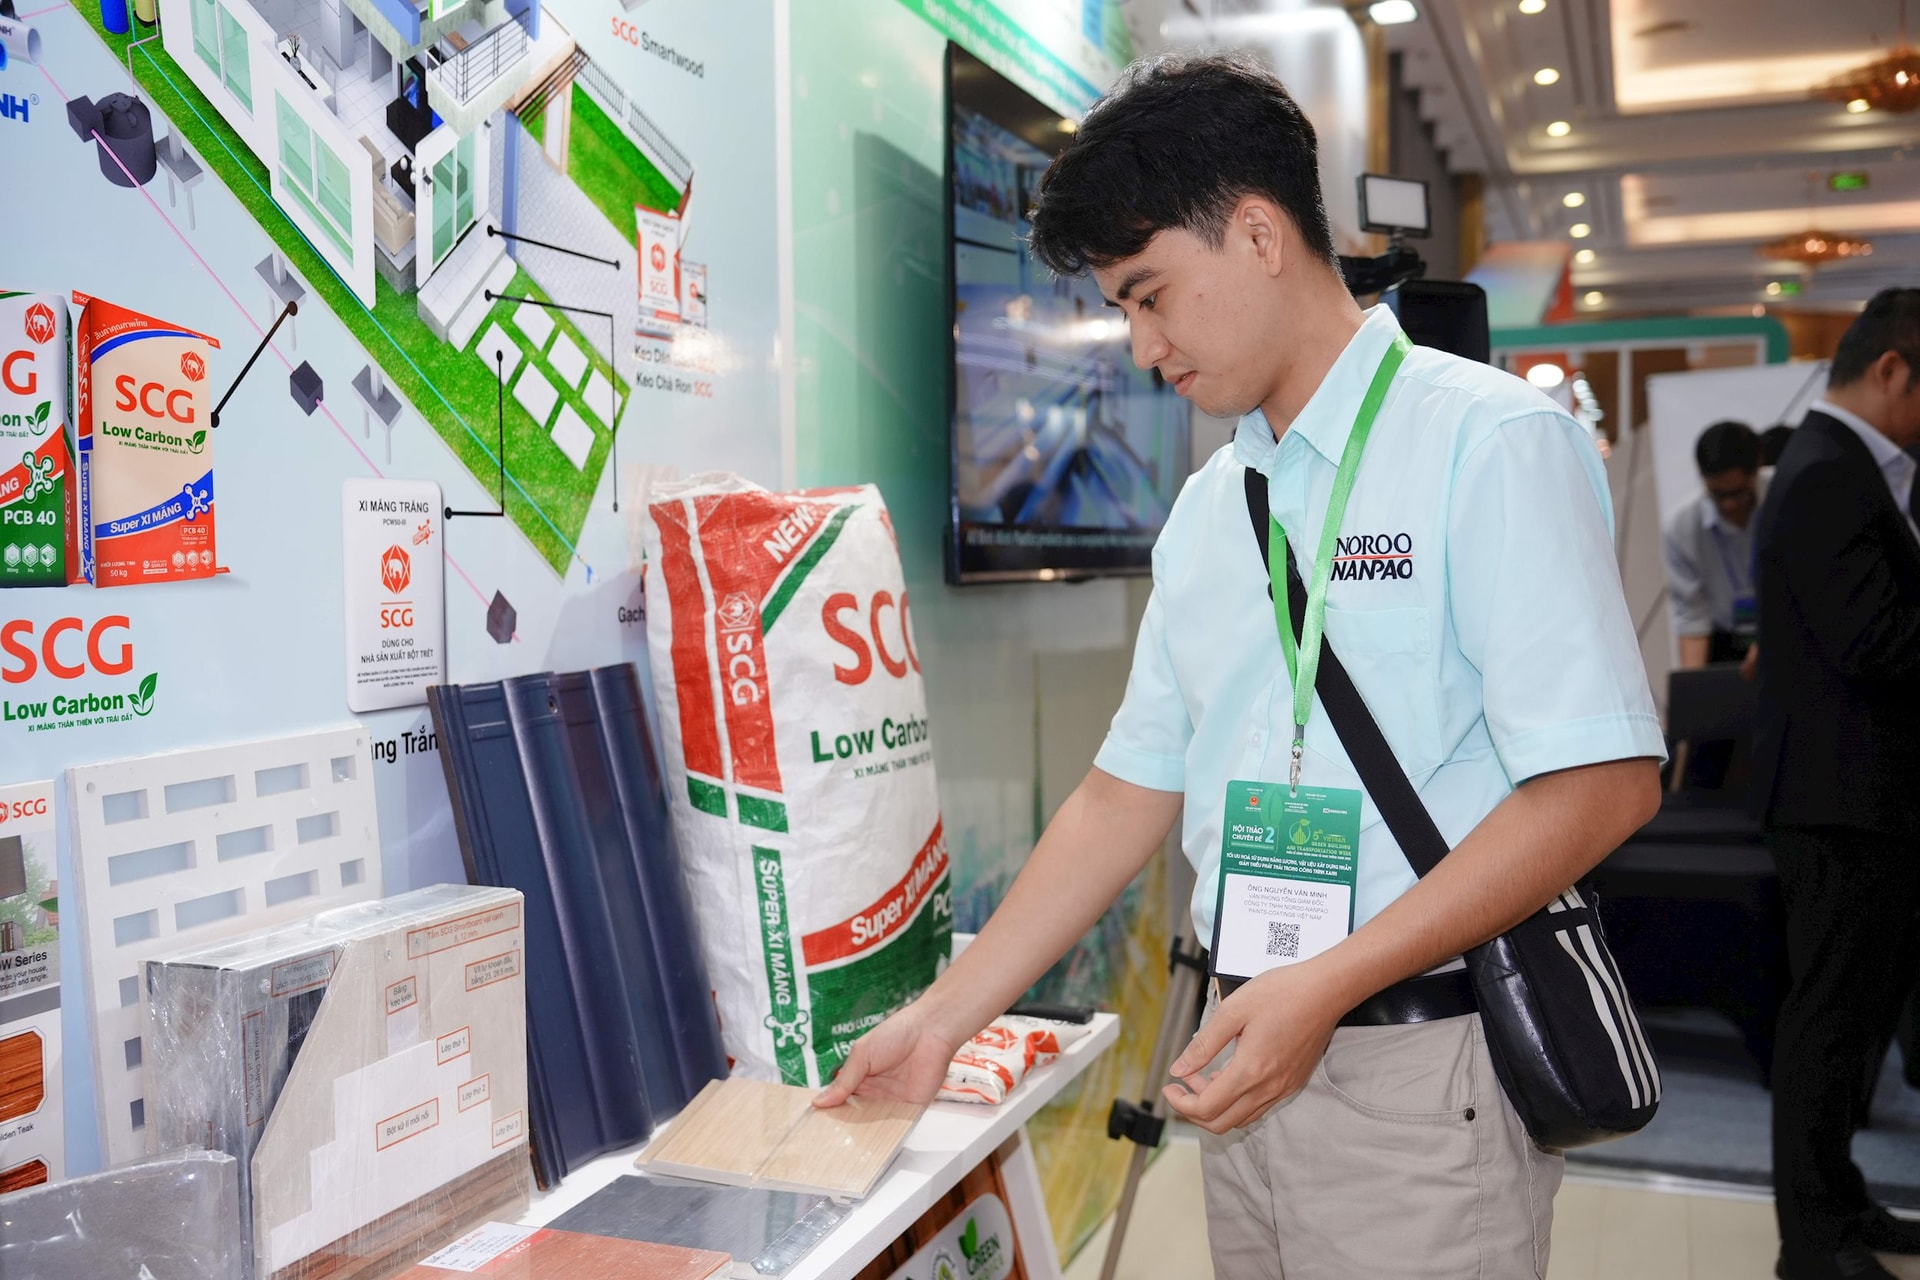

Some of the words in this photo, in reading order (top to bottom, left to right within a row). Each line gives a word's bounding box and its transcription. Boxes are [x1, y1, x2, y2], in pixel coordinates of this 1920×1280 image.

[612, 16, 638, 46] SCG
[641, 31, 704, 79] Smartwood
[636, 371, 653, 389] Keo
[675, 378, 693, 394] Ron
[693, 380, 713, 399] SCG
[115, 374, 195, 424] SCG
[0, 414, 21, 427] on
[102, 421, 132, 438] Low
[135, 426, 183, 447] Carbon
[359, 500, 368, 512] XI
[370, 498, 397, 513] MĂNG
[399, 500, 429, 513] TRẮNG
[4, 510, 34, 525] PCB
[36, 510, 56, 526] 40
[110, 519, 140, 534] Super
[141, 512, 151, 527] XI
[152, 501, 182, 523] MĂNG
[183, 527, 197, 535] PCB
[197, 527, 206, 535] 40
[763, 505, 815, 564] NEW
[1334, 533, 1412, 557] NOROO
[110, 569, 119, 577] 50
[119, 569, 128, 578] kg
[1330, 558, 1413, 581] NANPAO
[380, 608, 414, 629] SCG
[618, 606, 646, 628] Gạch
[0, 615, 134, 684] SCG
[381, 638, 400, 649] DÙNG
[400, 638, 414, 647] CHO
[361, 653, 375, 664] NHÀ
[390, 650, 406, 661] XUẤT
[407, 649, 419, 660] BỘT
[726, 633, 759, 706] SCG
[3, 701, 48, 722] Low
[52, 692, 124, 716] Carbon
[36, 721, 56, 731] MĂNG
[58, 719, 74, 729] THÂN
[76, 718, 93, 727] THIỆN
[94, 715, 104, 725] VỚI
[106, 714, 119, 724] TRÁI
[121, 713, 133, 722] ĐẤT
[810, 729, 875, 763] Low
[881, 713, 929, 750] Carbo
[371, 740, 397, 764] ng
[853, 767, 864, 779] XI
[13, 798, 47, 819] SCG
[1232, 824, 1245, 833] HỘI
[1245, 825, 1264, 835] THẢO
[1264, 826, 1275, 844] 2
[1296, 845, 1338, 855] TRANSPORTATION
[1328, 842, 1351, 850] BUILDING
[1247, 883, 1263, 892] ÔNG
[1264, 886, 1293, 895] NGUYỄN
[1294, 889, 1308, 897] VĂN
[1309, 891, 1328, 899] MINH
[1244, 899, 1260, 907] CÔNG
[440, 925, 453, 937] SCG
[454, 917, 483, 933] Smartboard
[851, 896, 904, 946] Super
[768, 930, 784, 948] XI
[15, 952, 48, 967] Series
[13, 970, 28, 981] your
[18, 978, 30, 986] and
[770, 952, 792, 1006] MĂNG
[254, 1030, 261, 1048] mm
[254, 1050, 261, 1061] 10
[441, 1044, 452, 1054] Lớp
[462, 1091, 472, 1101] Lớp
[482, 1083, 486, 1092] 2
[17, 1122, 35, 1135] Teak
